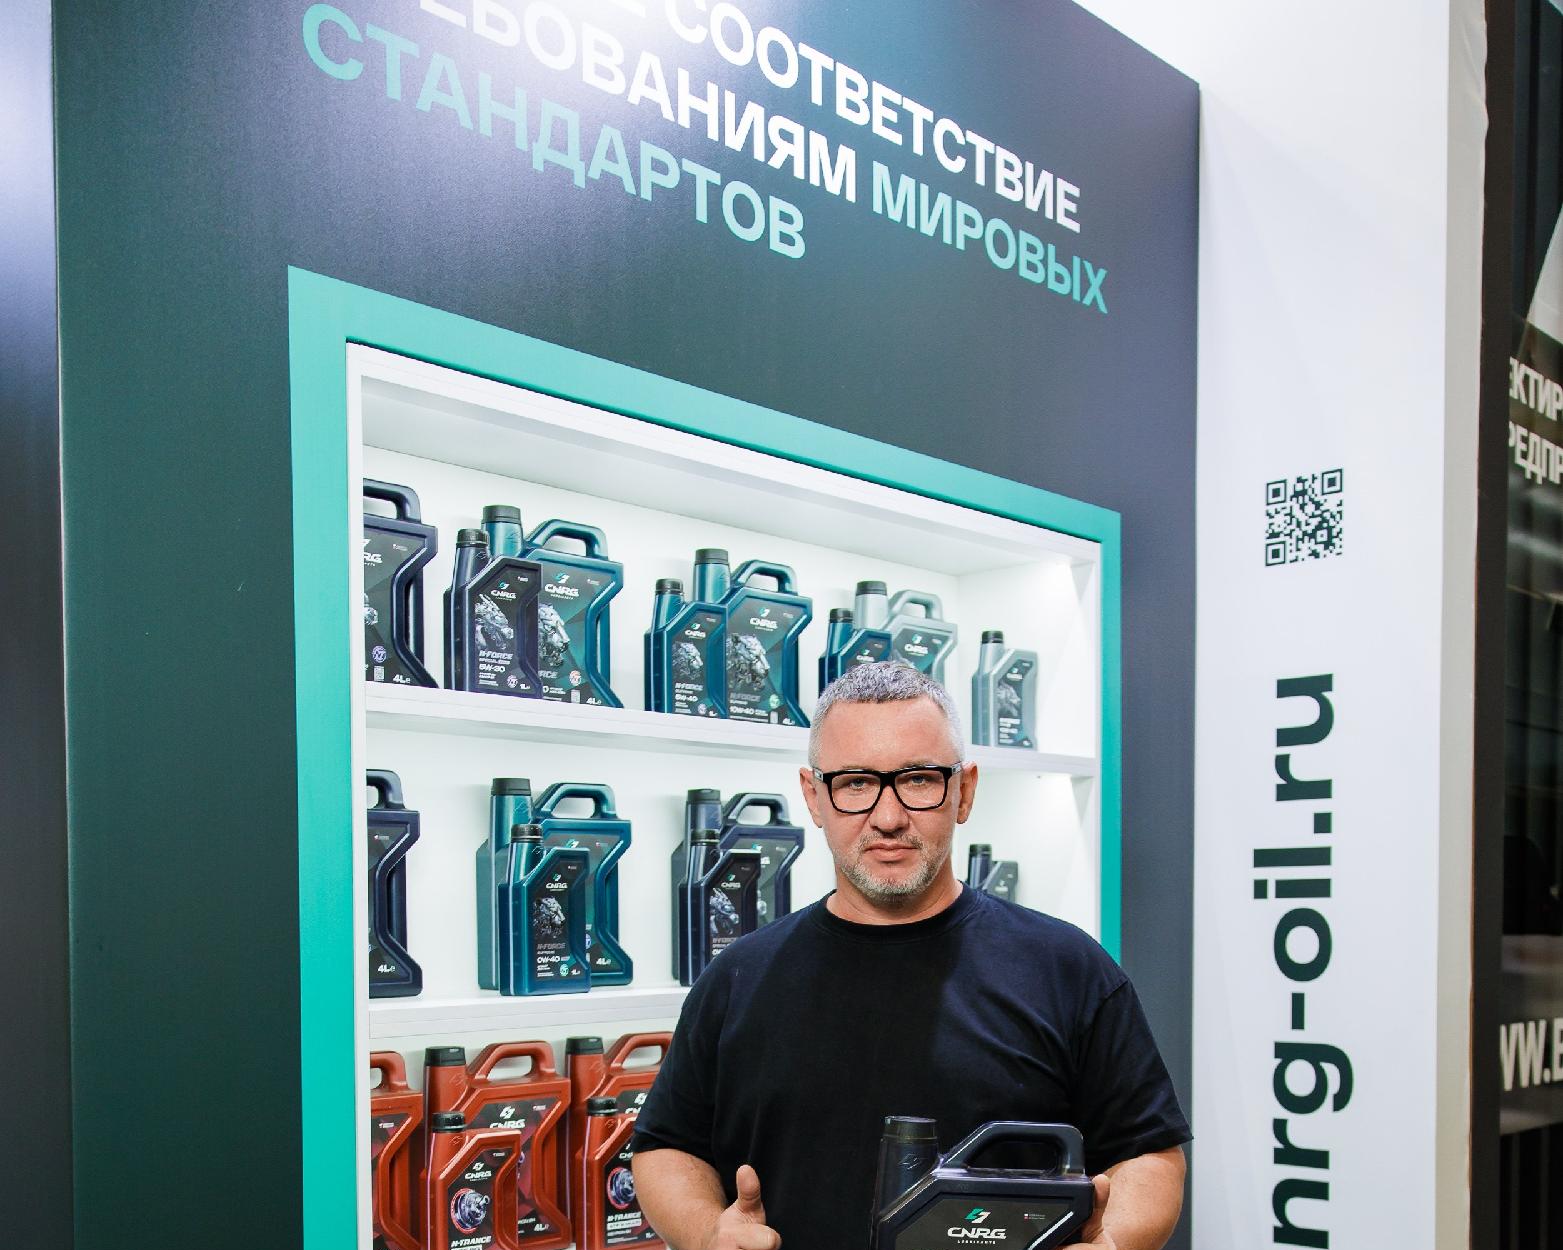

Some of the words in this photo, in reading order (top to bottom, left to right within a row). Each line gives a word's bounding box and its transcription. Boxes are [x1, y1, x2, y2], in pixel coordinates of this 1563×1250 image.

[303, 4, 807, 260] СТАНДАРТОВ
[420, 0, 857, 203] БОВАНИЯМ
[872, 160, 1108, 314] МИРОВЫХ
[663, 0, 1081, 233] СООТВЕТСТВИЕ
[490, 589, 517, 599] CNRG
[545, 583, 579, 597] CNRG
[947, 1226, 1007, 1240] CNRG
